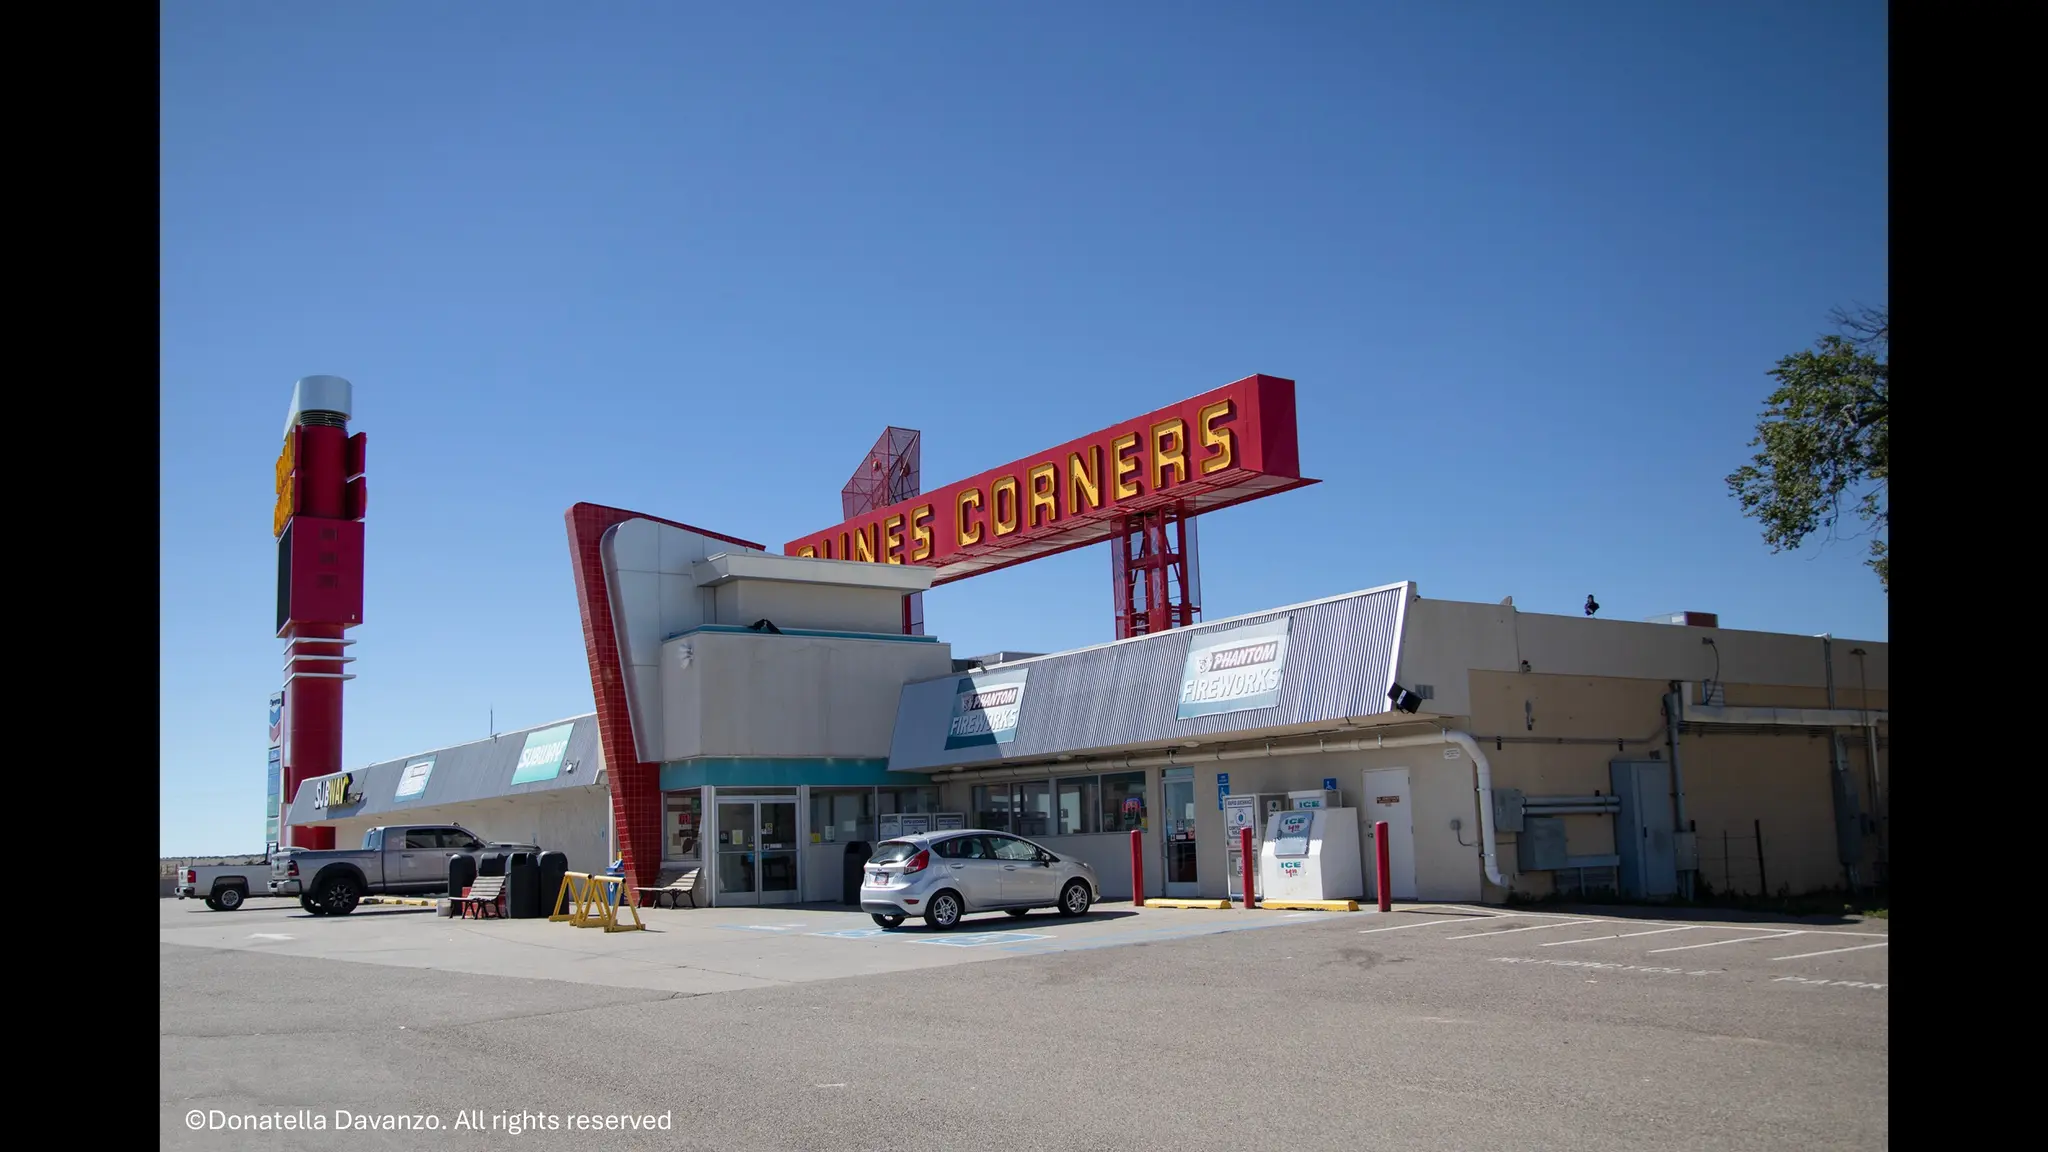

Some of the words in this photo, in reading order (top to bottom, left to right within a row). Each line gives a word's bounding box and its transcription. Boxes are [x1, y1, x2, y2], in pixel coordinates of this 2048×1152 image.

[797, 504, 931, 563] INES
[956, 399, 1232, 547] CORNERS
[1213, 643, 1276, 670] PHANTOM
[973, 688, 1017, 709] PHANTOM
[1182, 667, 1281, 703] FIREWORKS
[950, 709, 1018, 736] FIREWORKS
[314, 775, 349, 809] SUBWAY
[1299, 800, 1320, 808] ICE
[1280, 861, 1302, 869] ICE
